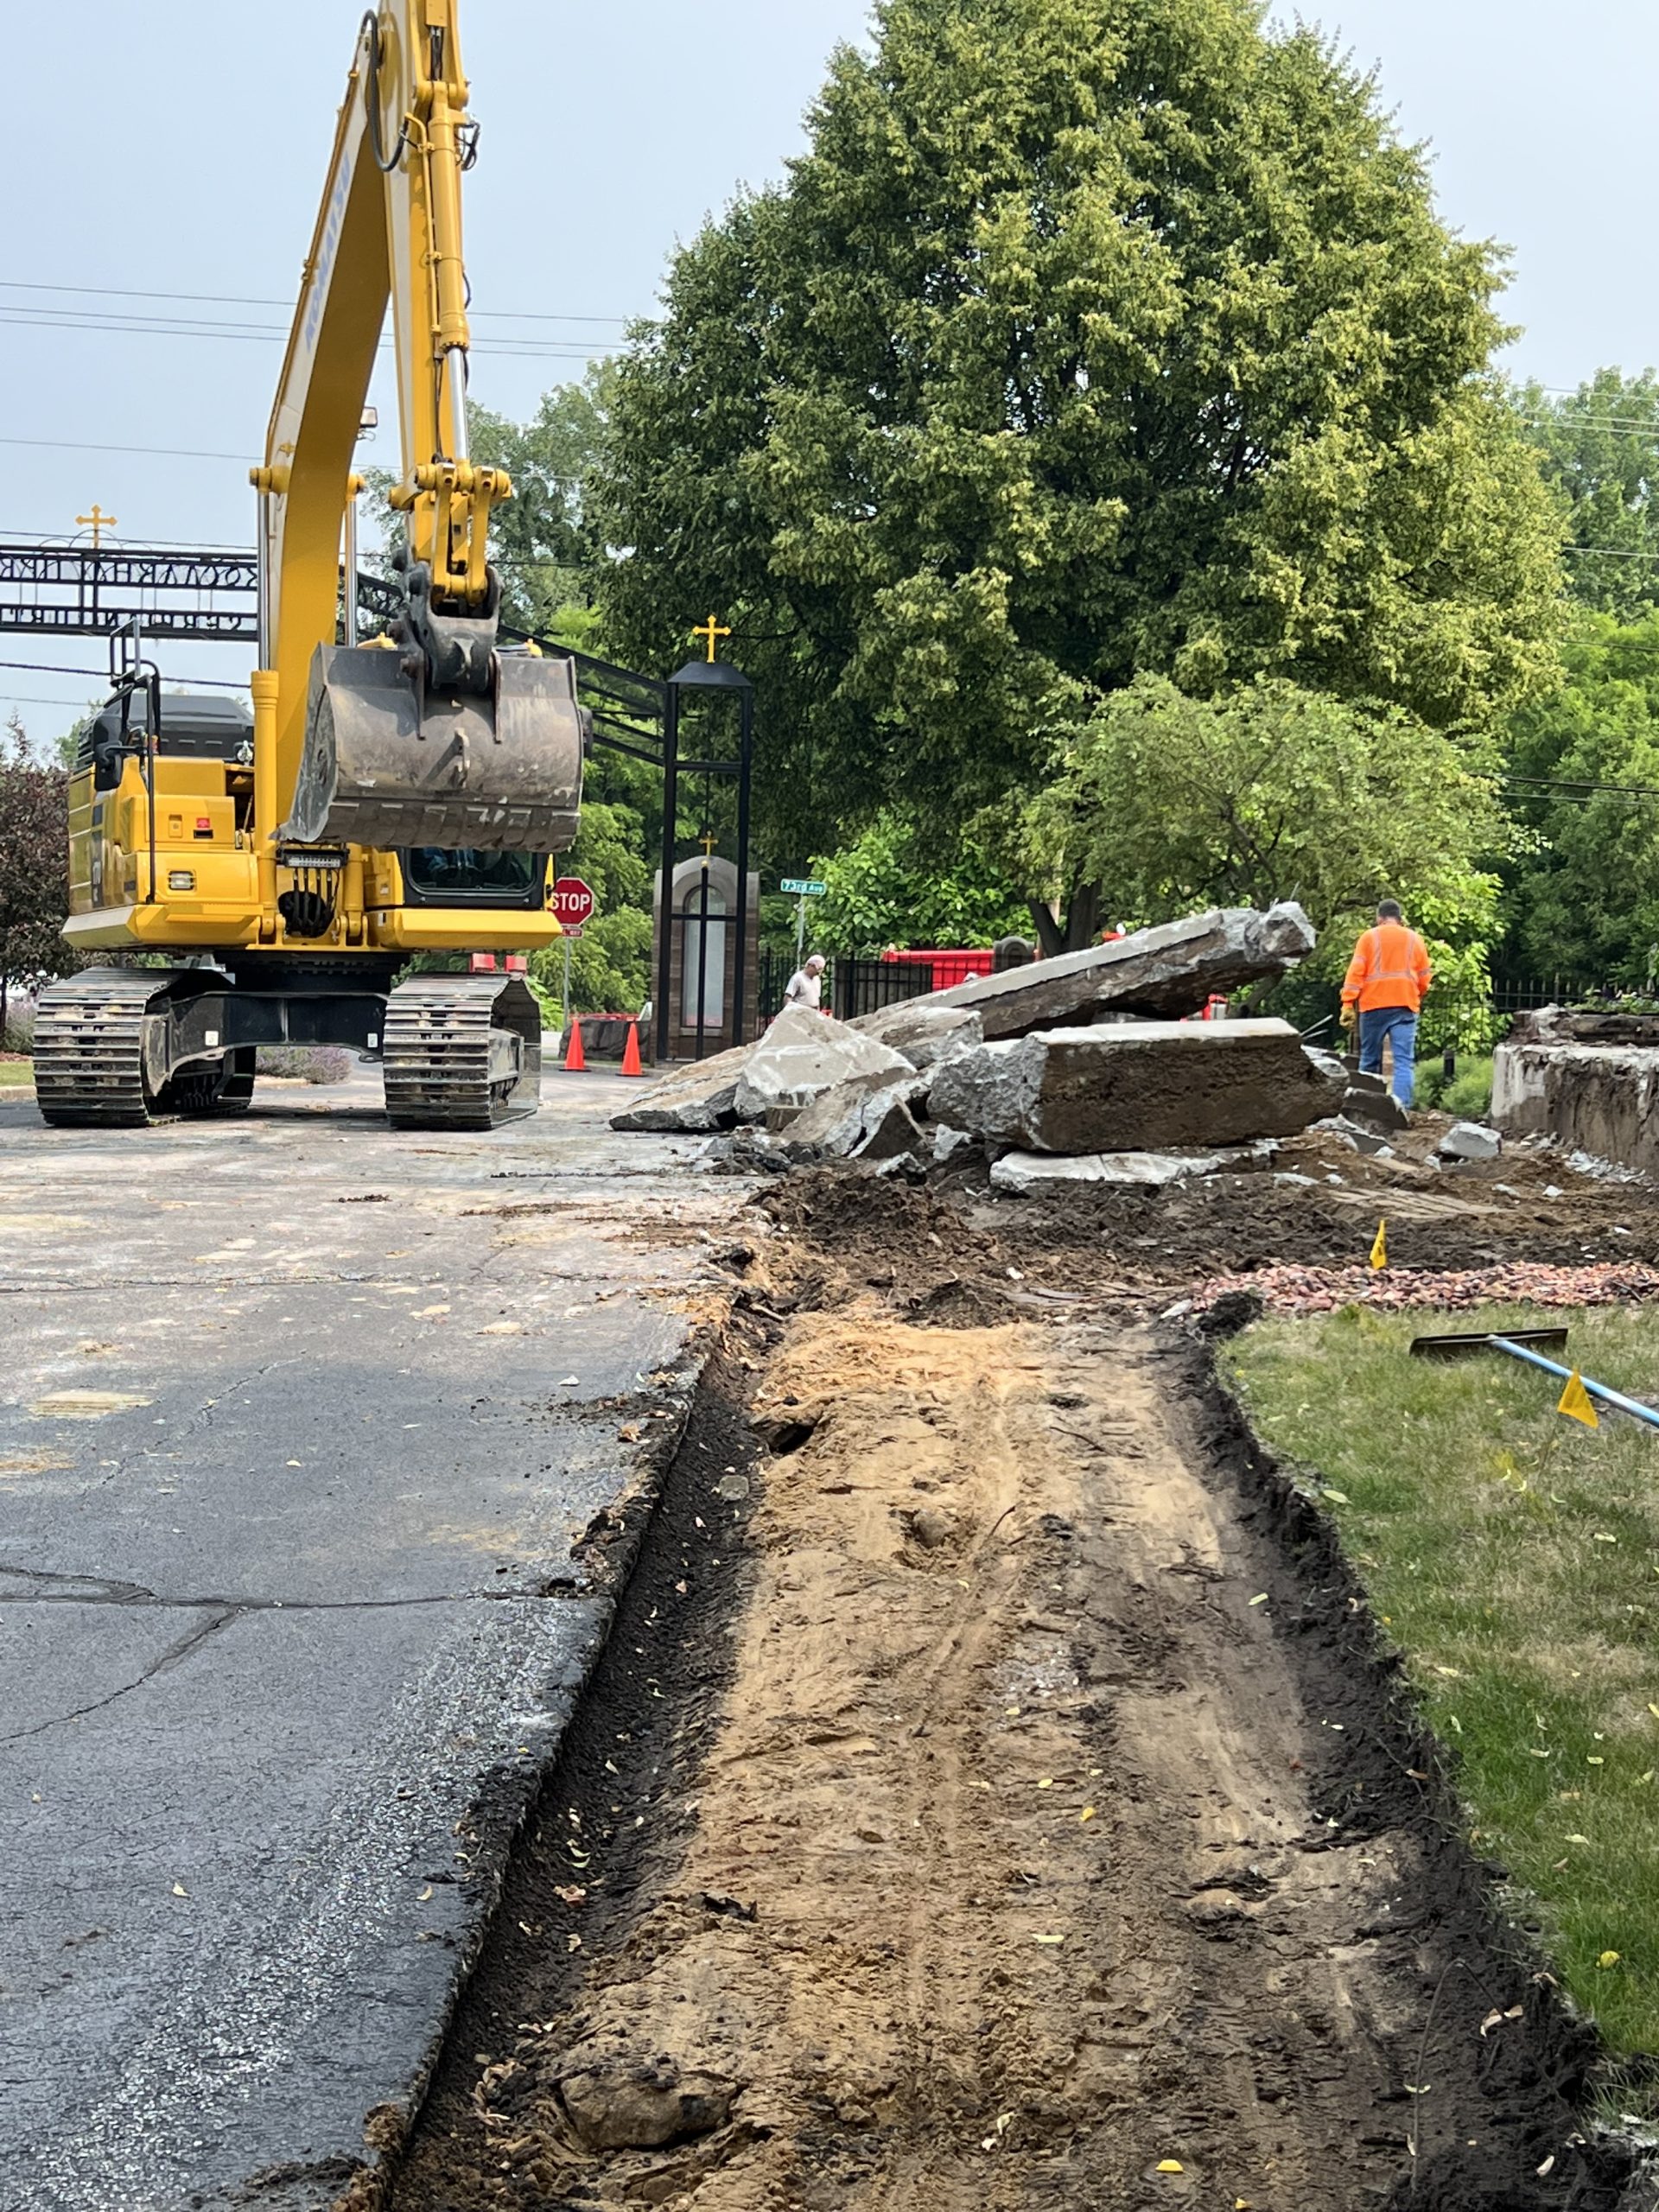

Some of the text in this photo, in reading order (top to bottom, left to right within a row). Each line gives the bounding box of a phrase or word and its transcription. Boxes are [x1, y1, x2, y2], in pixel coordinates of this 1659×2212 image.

[304, 149, 351, 353] KOMATSU
[785, 880, 807, 893] 73rd
[550, 893, 590, 912] STOP
